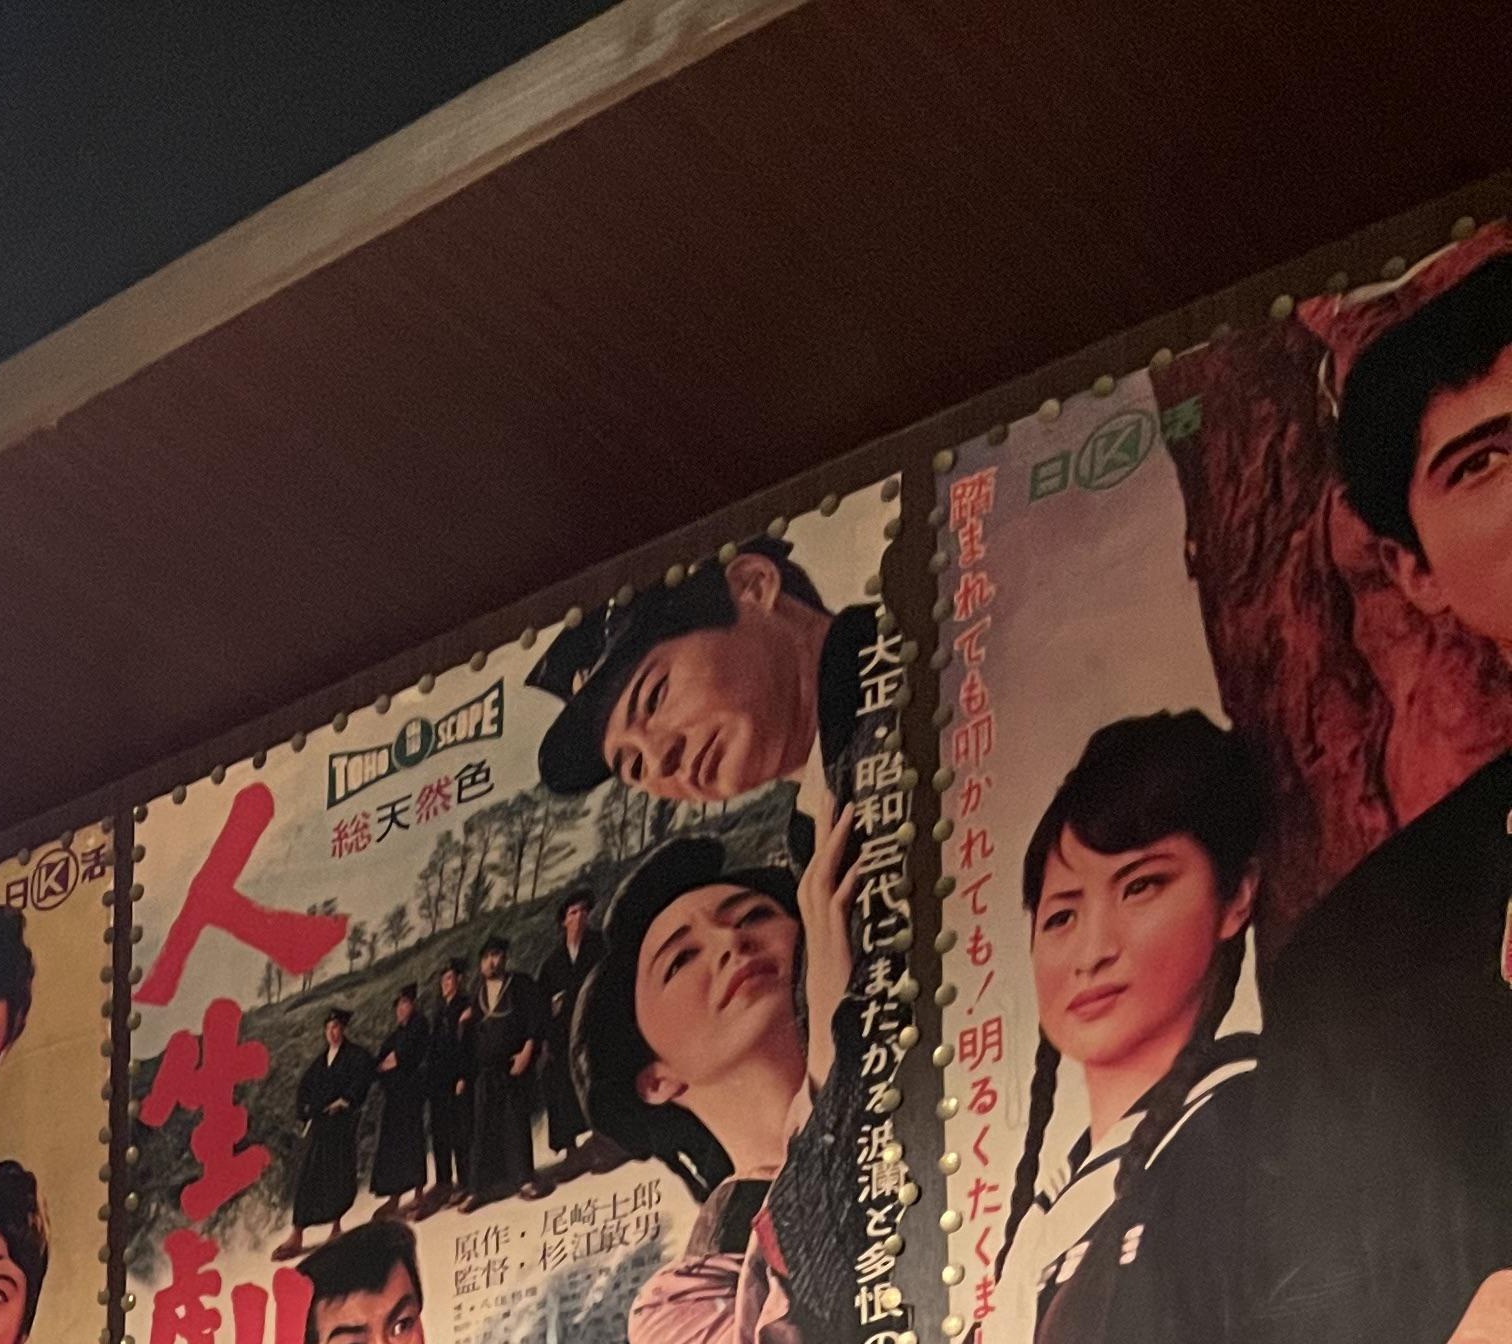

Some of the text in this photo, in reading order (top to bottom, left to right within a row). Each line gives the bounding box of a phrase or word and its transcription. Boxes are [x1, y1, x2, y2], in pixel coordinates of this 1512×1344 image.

[333, 744, 390, 796] TOHO
[436, 690, 501, 748] SCOPE
[331, 762, 494, 857] 総天然色
[455, 1179, 661, 1263] 原作・尾崎士郎
[455, 1212, 660, 1296] 監督・杉江敏男
